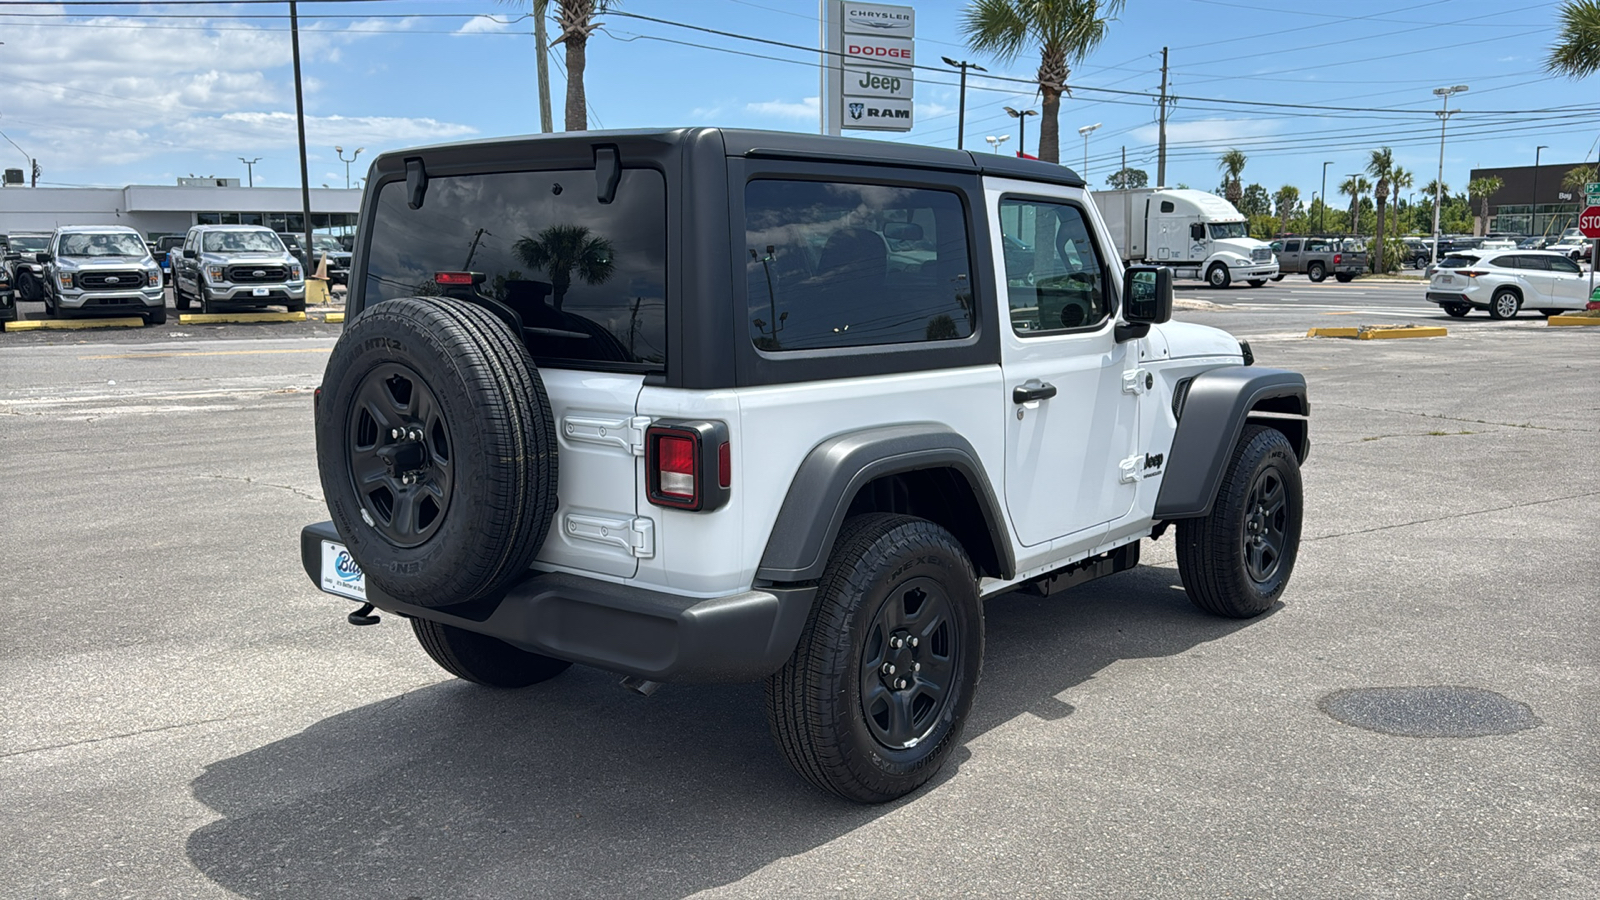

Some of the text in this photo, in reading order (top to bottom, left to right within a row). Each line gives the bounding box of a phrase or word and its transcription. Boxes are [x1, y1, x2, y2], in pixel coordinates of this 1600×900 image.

[850, 10, 910, 21] CHRYSLER
[849, 45, 911, 58] DODGE
[859, 71, 901, 94] Jeep
[867, 108, 910, 119] RAM
[1144, 452, 1164, 471] Jeep
